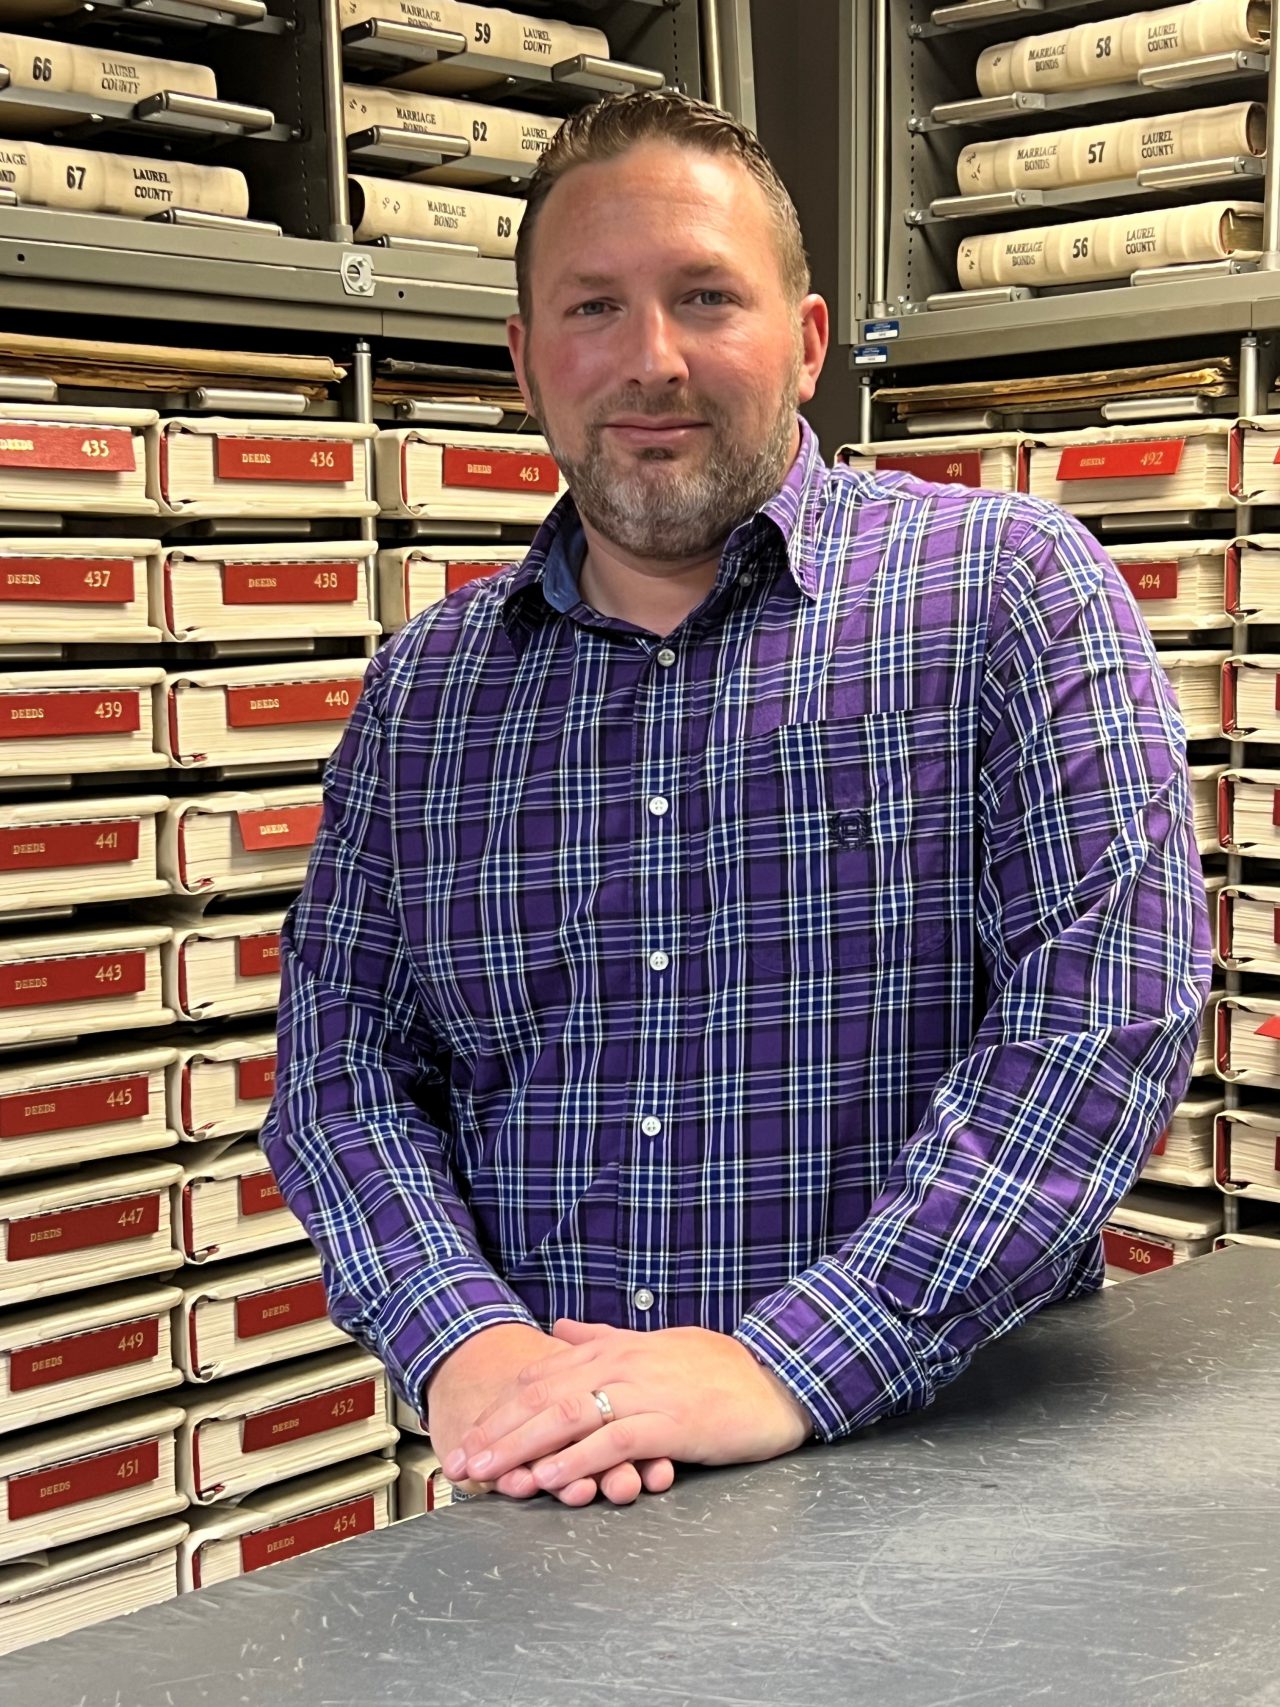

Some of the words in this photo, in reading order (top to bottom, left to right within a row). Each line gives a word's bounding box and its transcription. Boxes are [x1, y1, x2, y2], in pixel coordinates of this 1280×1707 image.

[400, 2, 441, 22] MARRIAGE
[475, 23, 491, 43] 59
[523, 28, 551, 41] LAUREL
[1148, 23, 1177, 39] LAUREL
[523, 41, 552, 54] COUNTY
[1096, 37, 1111, 57] 58
[1148, 35, 1179, 52] COUNTY
[1028, 45, 1065, 60] MARRIAGE
[33, 57, 51, 80] 66
[102, 63, 139, 78] LAUREL
[1035, 59, 1059, 72] BONDS
[102, 79, 139, 94] COUNTY
[397, 108, 436, 124] MARRIAGE
[473, 121, 487, 141] 62
[1142, 131, 1173, 145] LAUREL
[1017, 146, 1057, 159] MARRIAGE
[1088, 142, 1105, 163] 57
[1142, 143, 1175, 158] COUNTY
[1025, 159, 1050, 171] BONDS
[66, 166, 85, 189] 67
[133, 168, 170, 183] LAUREL
[135, 186, 172, 201] COUNTY
[428, 201, 466, 216] MARRIAGE
[434, 216, 458, 228] BONDS
[497, 216, 511, 237] 63
[1126, 227, 1155, 241] LAUREL
[1073, 238, 1089, 258] 56
[1126, 241, 1156, 254] COUNTY
[1012, 255, 1035, 266] BONDS
[82, 440, 109, 457] 435
[242, 454, 271, 463] DEEDS
[310, 452, 334, 467] 436
[1141, 452, 1163, 465] 492
[468, 464, 491, 474] DEEDS
[520, 467, 539, 481] 463
[947, 463, 962, 476] 491
[8, 574, 40, 584] DEEDS
[84, 571, 110, 587] 437
[249, 578, 277, 587] DEEDS
[314, 573, 337, 588] 438
[1139, 575, 1160, 589] 494
[250, 699, 279, 709] DEEDS
[325, 690, 349, 706] 440
[12, 708, 44, 719] DEEDS
[95, 702, 122, 718] 439
[260, 824, 289, 835] DEEDS
[13, 843, 45, 854] DEEDS
[96, 833, 117, 848] 441
[263, 947, 279, 957] DEE
[16, 978, 47, 990] DEEDS
[95, 965, 121, 982] 443
[25, 1103, 55, 1116] DEEDS
[107, 1089, 132, 1107] 445
[261, 1186, 279, 1197] DEE
[30, 1228, 61, 1242] DEEDS
[118, 1208, 143, 1226] 447
[1129, 1247, 1150, 1264] 506
[262, 1304, 289, 1319] DEEDS
[32, 1356, 62, 1372] DEEDS
[118, 1332, 143, 1351] 449
[272, 1419, 299, 1433] DEEDS
[332, 1399, 353, 1416] 452
[40, 1481, 70, 1497] DEEDS
[117, 1459, 138, 1478] 451
[267, 1536, 294, 1553] DEEDS
[334, 1513, 356, 1532] 454
